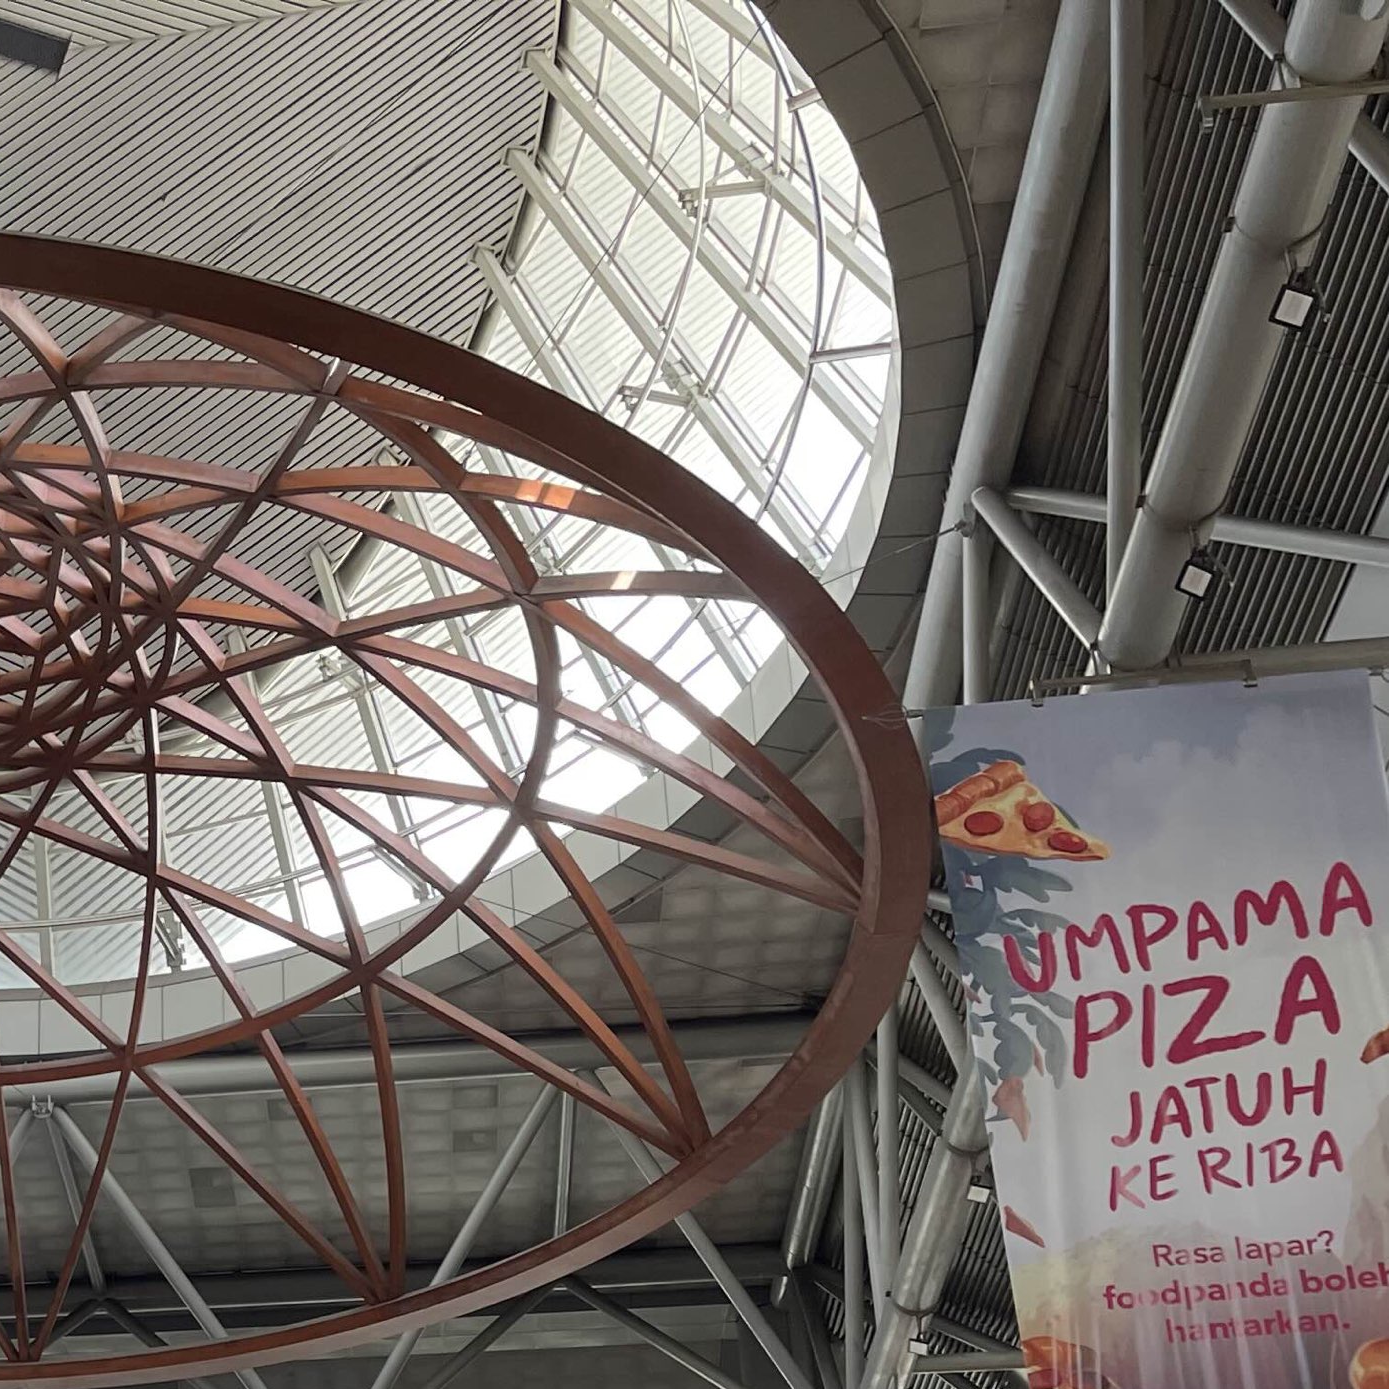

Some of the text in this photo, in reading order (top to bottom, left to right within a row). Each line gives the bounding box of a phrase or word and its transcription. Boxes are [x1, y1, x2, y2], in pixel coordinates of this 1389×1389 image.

[1002, 861, 1373, 993] UMPAMA
[1071, 954, 1342, 1080] PIZA
[1110, 1058, 1328, 1147] JATUH
[1109, 1130, 1345, 1211] KE RIBA
[1151, 1230, 1335, 1268] Rasa lapar?
[1165, 1309, 1351, 1344] hantarkan.
